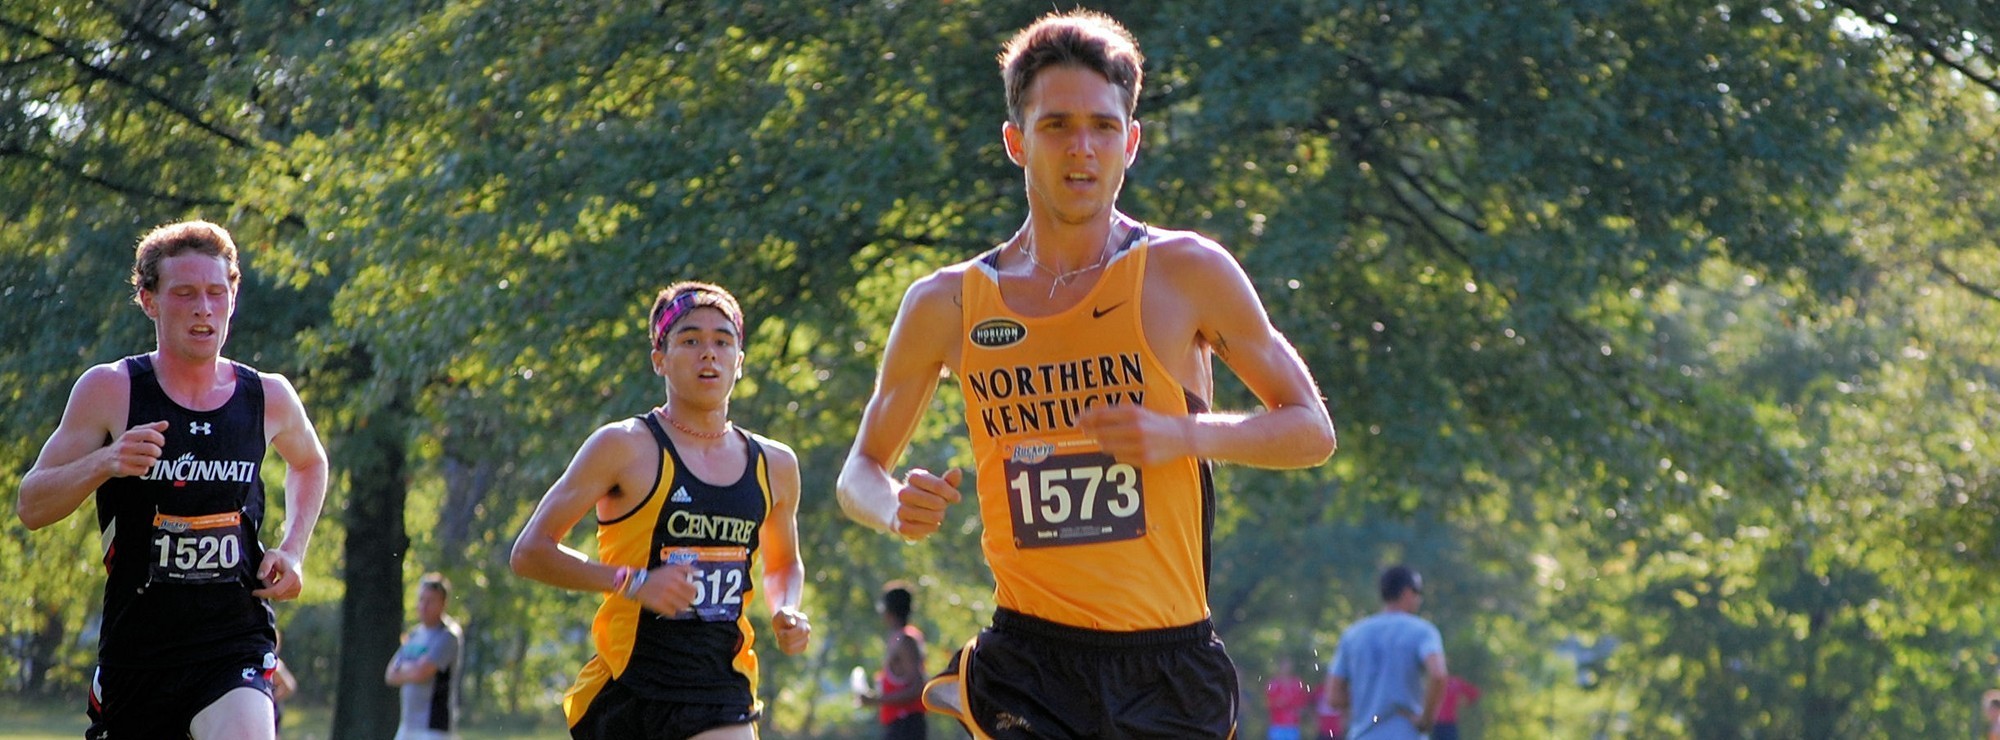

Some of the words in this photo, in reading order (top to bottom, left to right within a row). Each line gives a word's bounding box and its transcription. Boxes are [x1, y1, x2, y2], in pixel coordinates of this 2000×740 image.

[977, 327, 1018, 338] HORIZON
[968, 353, 1144, 402] NORTHERN
[139, 459, 255, 483] INCINNATI
[1011, 463, 1140, 524] 1573
[667, 510, 756, 543] CENTRE
[155, 535, 240, 569] 1520
[686, 569, 742, 605] 512
